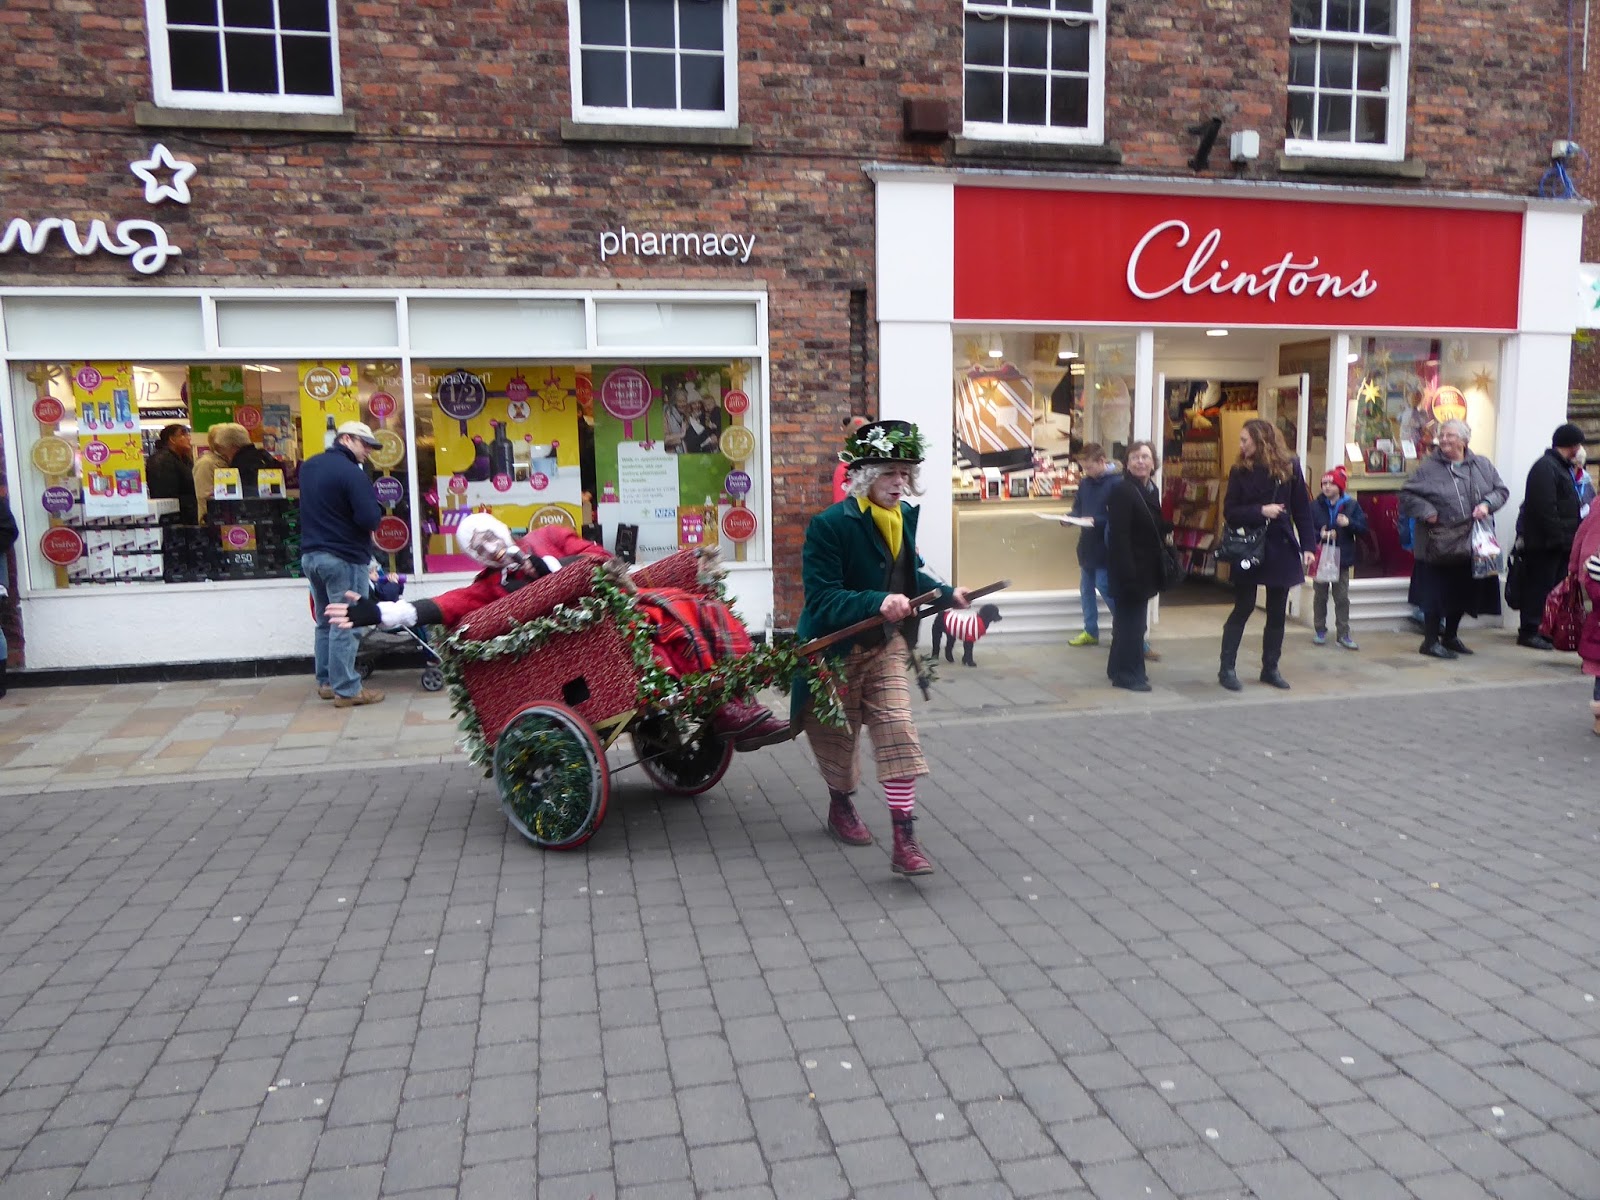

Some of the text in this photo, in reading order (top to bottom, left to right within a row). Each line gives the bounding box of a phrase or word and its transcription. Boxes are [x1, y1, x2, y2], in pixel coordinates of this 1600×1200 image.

[600, 225, 756, 264] pharmacy
[1126, 218, 1378, 303] Clintons
[540, 515, 564, 524] now
